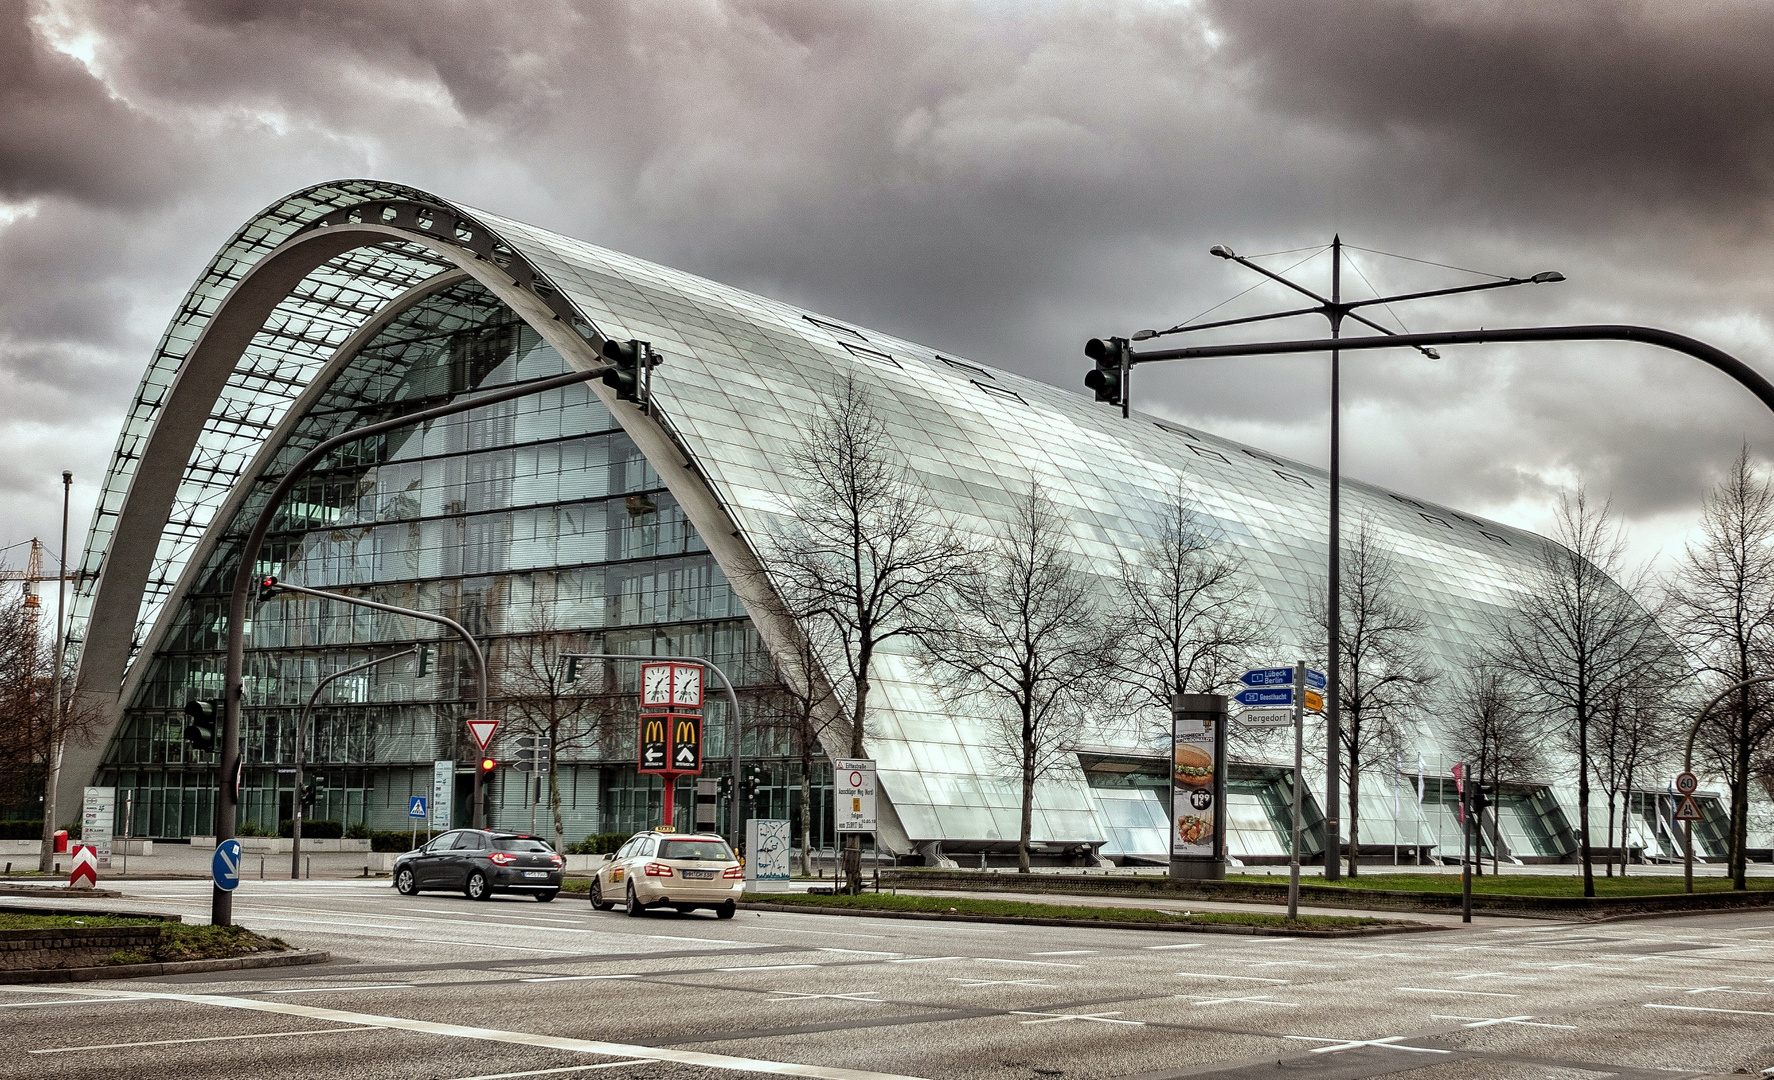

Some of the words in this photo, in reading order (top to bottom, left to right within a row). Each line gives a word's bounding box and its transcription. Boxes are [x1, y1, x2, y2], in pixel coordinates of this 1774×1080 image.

[1264, 670, 1287, 678] Lübeck
[1247, 713, 1286, 723] Bergedorf
[1680, 778, 1693, 788] 60
